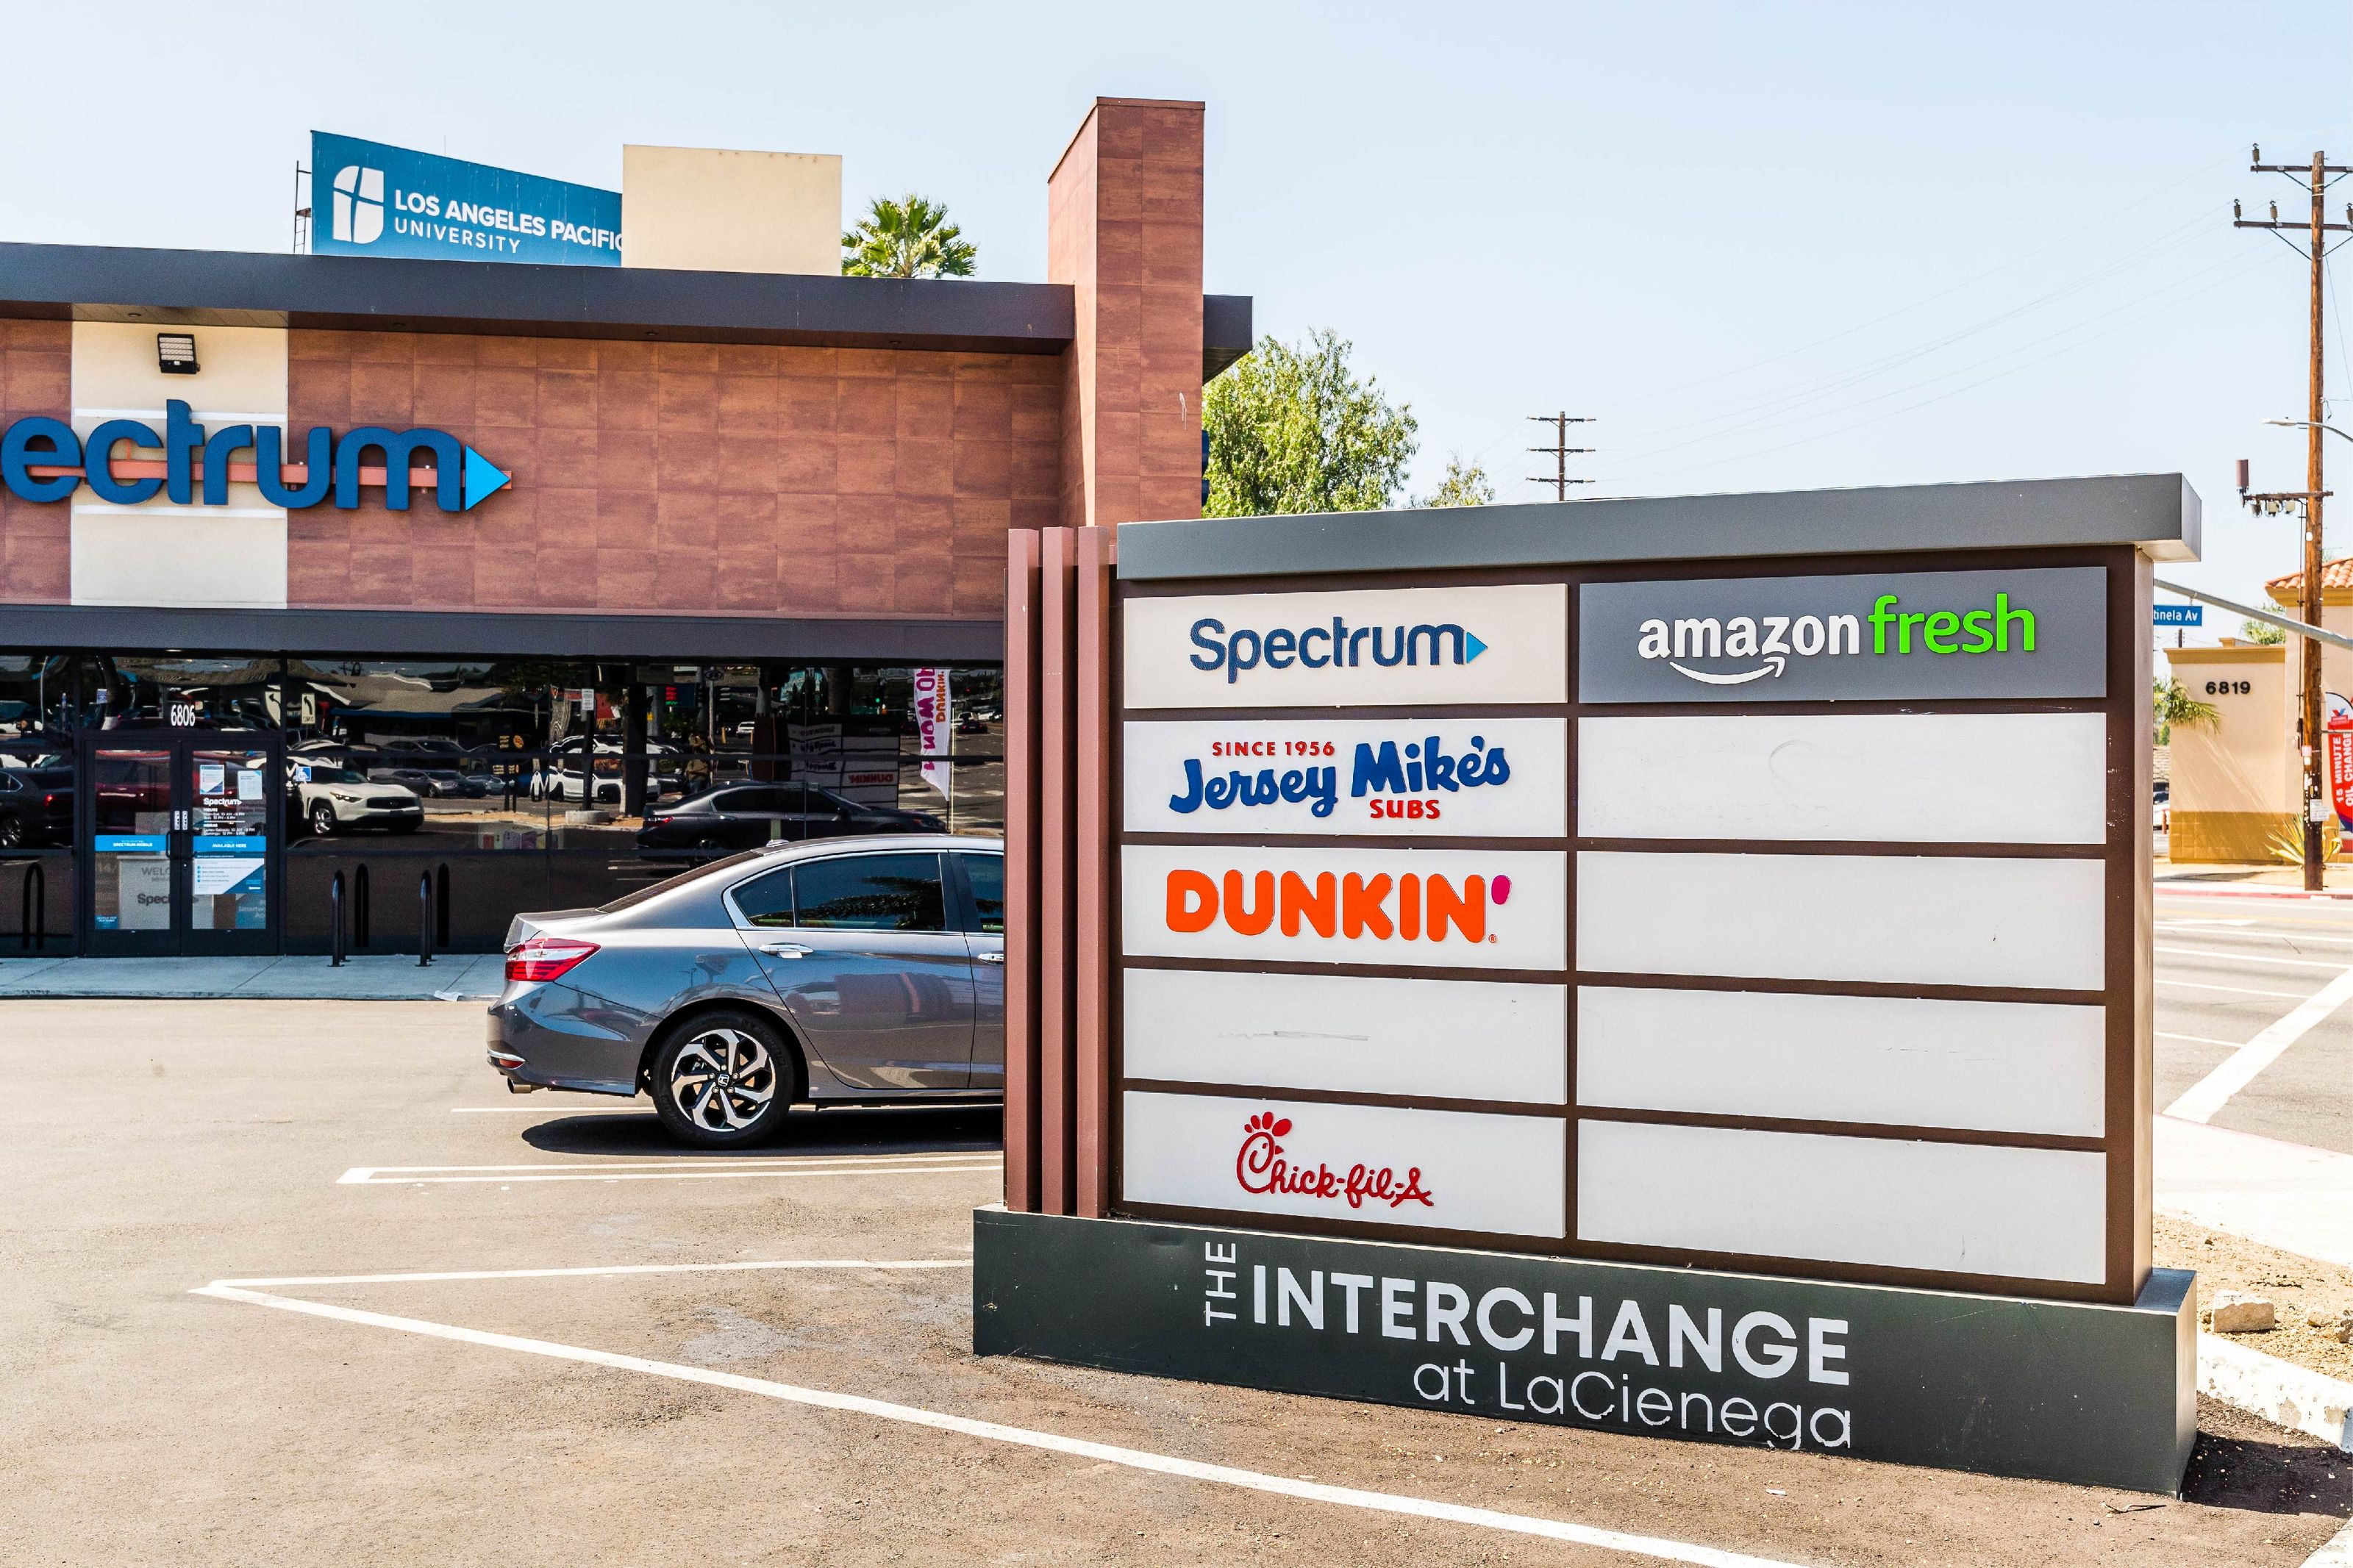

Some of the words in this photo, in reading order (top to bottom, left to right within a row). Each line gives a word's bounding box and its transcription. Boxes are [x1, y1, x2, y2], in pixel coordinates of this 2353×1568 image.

[394, 217, 521, 254] UNIVERSITY
[395, 189, 440, 218] LOS
[444, 201, 546, 237] ANGELES
[1638, 614, 1860, 659] amazon
[1867, 593, 2035, 655] fresh
[2185, 609, 2199, 621] Av
[1190, 616, 1465, 684] Spectrum
[2205, 681, 2251, 695] 6819
[171, 704, 196, 726] 6806
[1212, 741, 1276, 756] SINCE
[1285, 740, 1336, 756] 1956
[2332, 737, 2343, 784] MINUTE
[2343, 731, 2353, 783] CHANGE
[1168, 759, 1339, 818] Jersey
[1351, 735, 1510, 798] Mike's
[2336, 788, 2344, 803] 15
[2344, 786, 2353, 807] OIL
[204, 798, 239, 806] Spectrum
[1369, 798, 1440, 819] SUBS
[138, 892, 170, 906] Spec
[1165, 869, 1512, 943] DUNKIN'
[1236, 1130, 1435, 1209] Chick-fil-A
[1204, 1241, 1236, 1326] THE
[1252, 1264, 1850, 1386] INTERCHANGE
[1413, 1358, 1475, 1406] at
[1499, 1361, 1852, 1450] LaCienega
